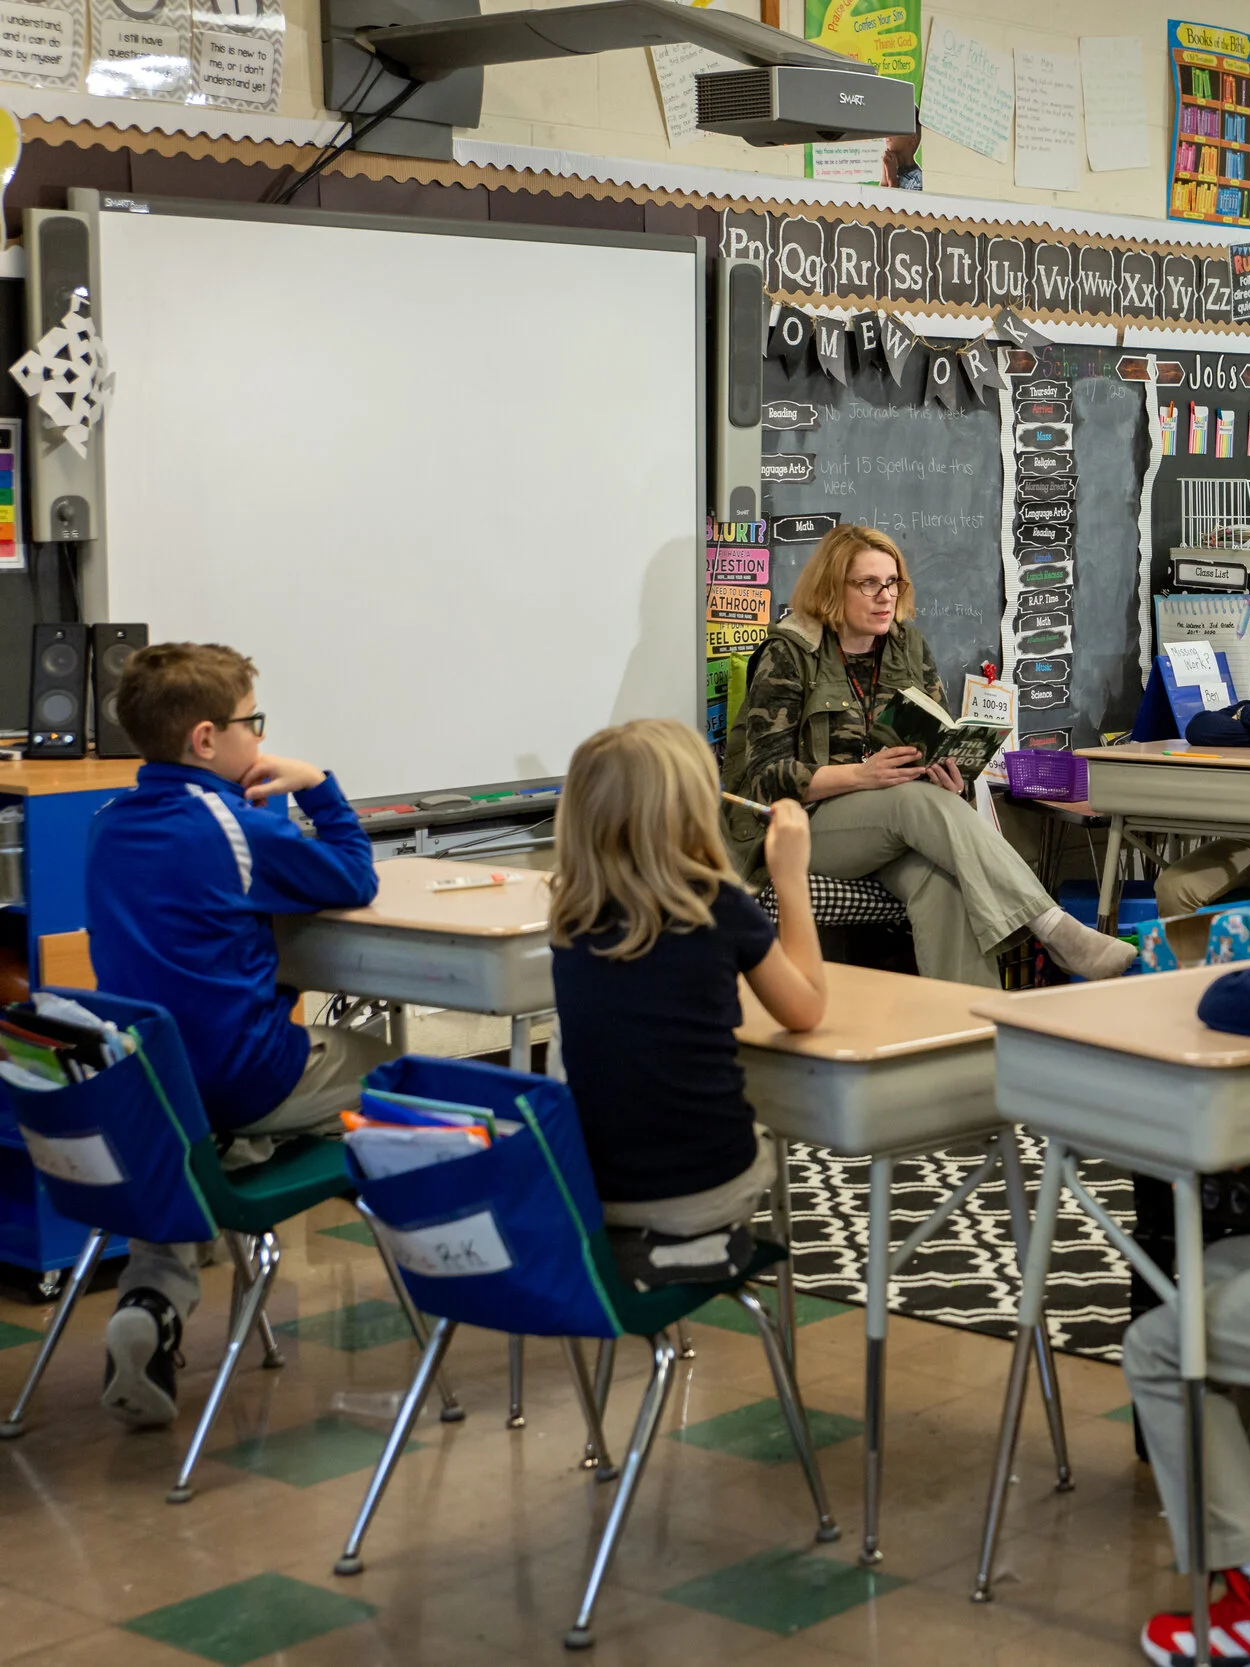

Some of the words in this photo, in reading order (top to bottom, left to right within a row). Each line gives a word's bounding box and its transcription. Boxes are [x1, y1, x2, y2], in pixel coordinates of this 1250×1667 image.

[7, 16, 63, 33] understand,
[853, 17, 877, 33] Confess
[877, 14, 891, 26] Your
[892, 9, 904, 22] Sins
[3, 32, 20, 42] and
[28, 36, 46, 45] can
[49, 37, 61, 48] do
[124, 33, 140, 45] still
[141, 36, 164, 47] have
[896, 35, 912, 48] God
[1186, 27, 1213, 47] Books
[1213, 37, 1221, 49] of
[1221, 37, 1230, 50] the
[1230, 35, 1246, 54] Bible
[16, 50, 28, 62] by
[210, 42, 228, 54] This
[229, 45, 236, 55] is
[236, 47, 256, 58] new
[257, 50, 267, 61] to
[943, 29, 965, 55] Our
[968, 39, 1000, 79] Father
[208, 59, 225, 72] me,
[227, 62, 237, 71] or
[243, 63, 265, 77] don't
[891, 59, 911, 71] Others
[203, 74, 251, 90] understand
[839, 92, 865, 105] SMART
[781, 242, 823, 292] Qq
[839, 247, 872, 285] Rr
[894, 252, 922, 290] Ss
[946, 247, 972, 285] Tt
[990, 260, 1023, 296] Uu
[1037, 264, 1070, 300] Vv
[1081, 270, 1113, 297] Ww
[1123, 273, 1154, 308] Xx
[1166, 275, 1193, 318] Yy
[1206, 278, 1232, 310] Zz
[1188, 353, 1239, 391] Jobs
[1029, 386, 1058, 398] Thursday
[768, 406, 798, 421] Reading
[824, 403, 841, 422] No
[848, 401, 899, 421] Journals
[907, 403, 932, 421] this
[938, 407, 969, 421] week
[1031, 404, 1054, 415] Arrival
[1036, 431, 1052, 442] Mass
[761, 463, 788, 478] nguage
[788, 462, 806, 475] Arts
[820, 454, 851, 476] Unit
[856, 456, 873, 475] 15
[876, 455, 926, 480] Spelling
[927, 458, 948, 475] due
[948, 458, 974, 476] this
[1033, 457, 1057, 469] Religion
[823, 478, 857, 497] week
[1024, 482, 1049, 494] Morning
[1050, 481, 1068, 492] Break
[1024, 508, 1052, 520] Language
[1053, 506, 1067, 518] Arts
[795, 520, 815, 532] Math
[911, 510, 958, 535] Fluency
[960, 507, 985, 529] test
[1032, 527, 1056, 540] Reading
[1033, 552, 1052, 563] Lunch
[1026, 571, 1044, 582] Lunch
[1195, 567, 1214, 578] Class
[1214, 569, 1230, 579] List
[738, 589, 750, 597] USE
[752, 590, 763, 599] THE
[1028, 596, 1045, 606] R.A.P.
[1045, 595, 1059, 605] Time
[710, 596, 766, 613] ATHROOM
[930, 598, 951, 617] due
[954, 603, 984, 625] Friday
[1036, 617, 1051, 627] Math
[733, 628, 767, 644] GOOD
[1170, 646, 1199, 661] Missing
[1035, 662, 1052, 673] Music
[1184, 653, 1212, 671] Work?
[1030, 689, 1053, 700] Science
[1204, 689, 1220, 702] Ben
[972, 696, 978, 707] A
[982, 698, 1008, 712] 100-93
[959, 740, 987, 749] THE
[947, 748, 987, 758] WILD
[937, 756, 986, 767] RBOT
